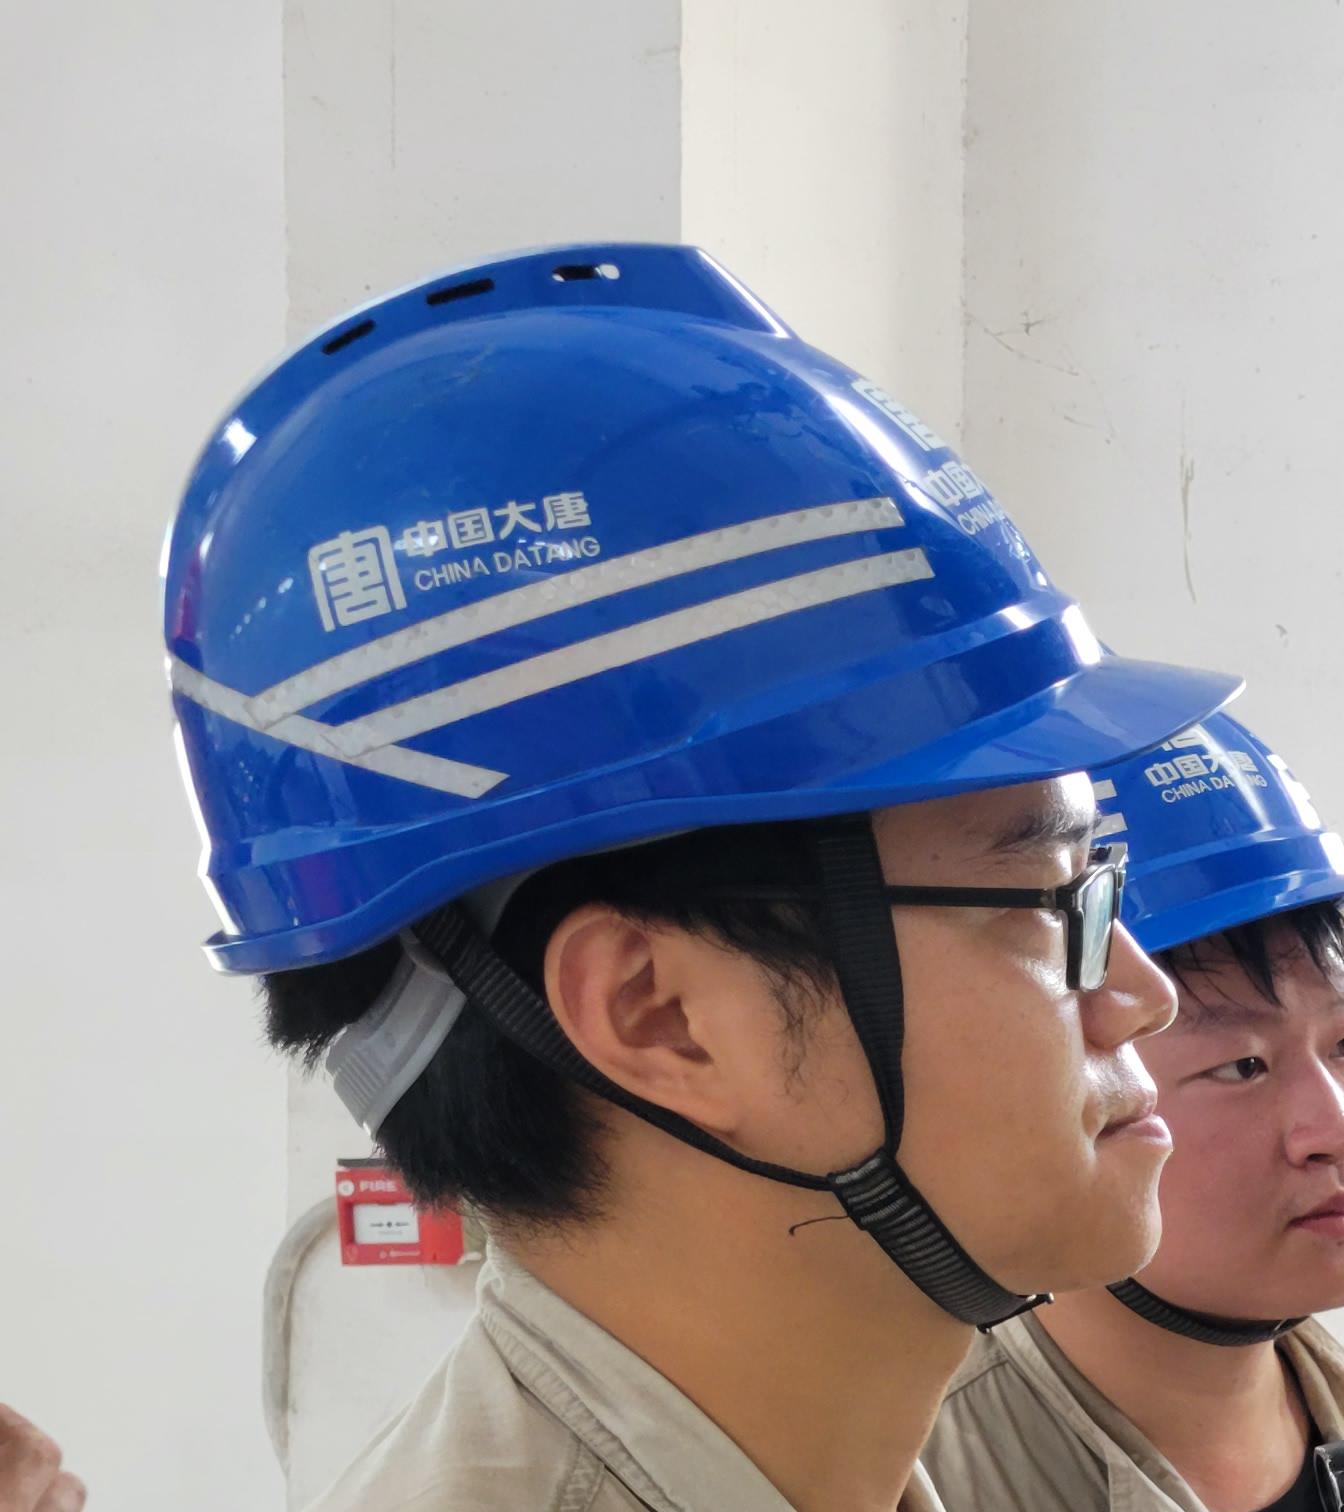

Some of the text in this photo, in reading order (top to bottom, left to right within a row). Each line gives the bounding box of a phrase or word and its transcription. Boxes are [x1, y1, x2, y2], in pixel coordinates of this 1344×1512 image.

[403, 492, 592, 557] 中国大唐
[414, 535, 600, 591] CHINA DATANG
[1161, 774, 1268, 803] CHINA DANG
[359, 1180, 397, 1192] FIRE
